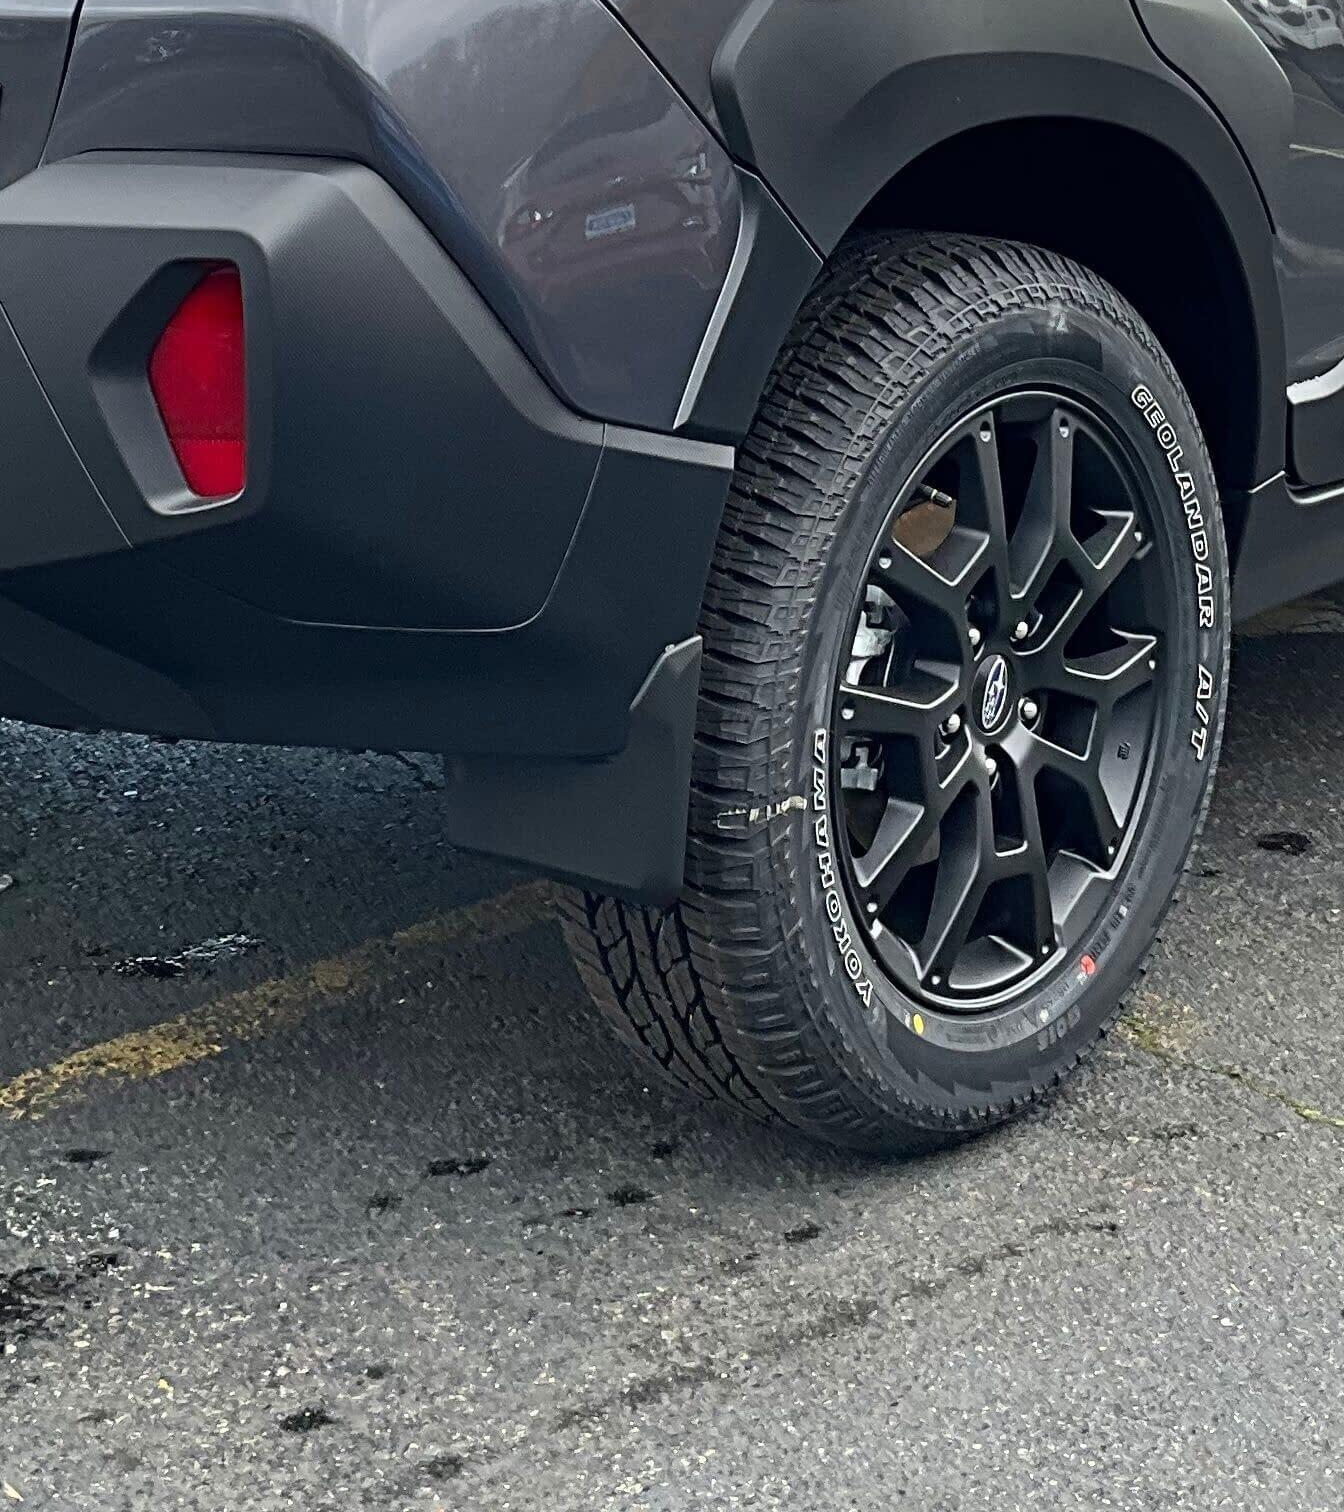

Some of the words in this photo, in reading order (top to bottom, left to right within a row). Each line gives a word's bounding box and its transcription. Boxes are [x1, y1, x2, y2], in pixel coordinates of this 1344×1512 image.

[1131, 384, 1214, 628] GEOLANDAR
[1190, 663, 1214, 761] A/T
[812, 728, 874, 1008] YOKOHAMA
